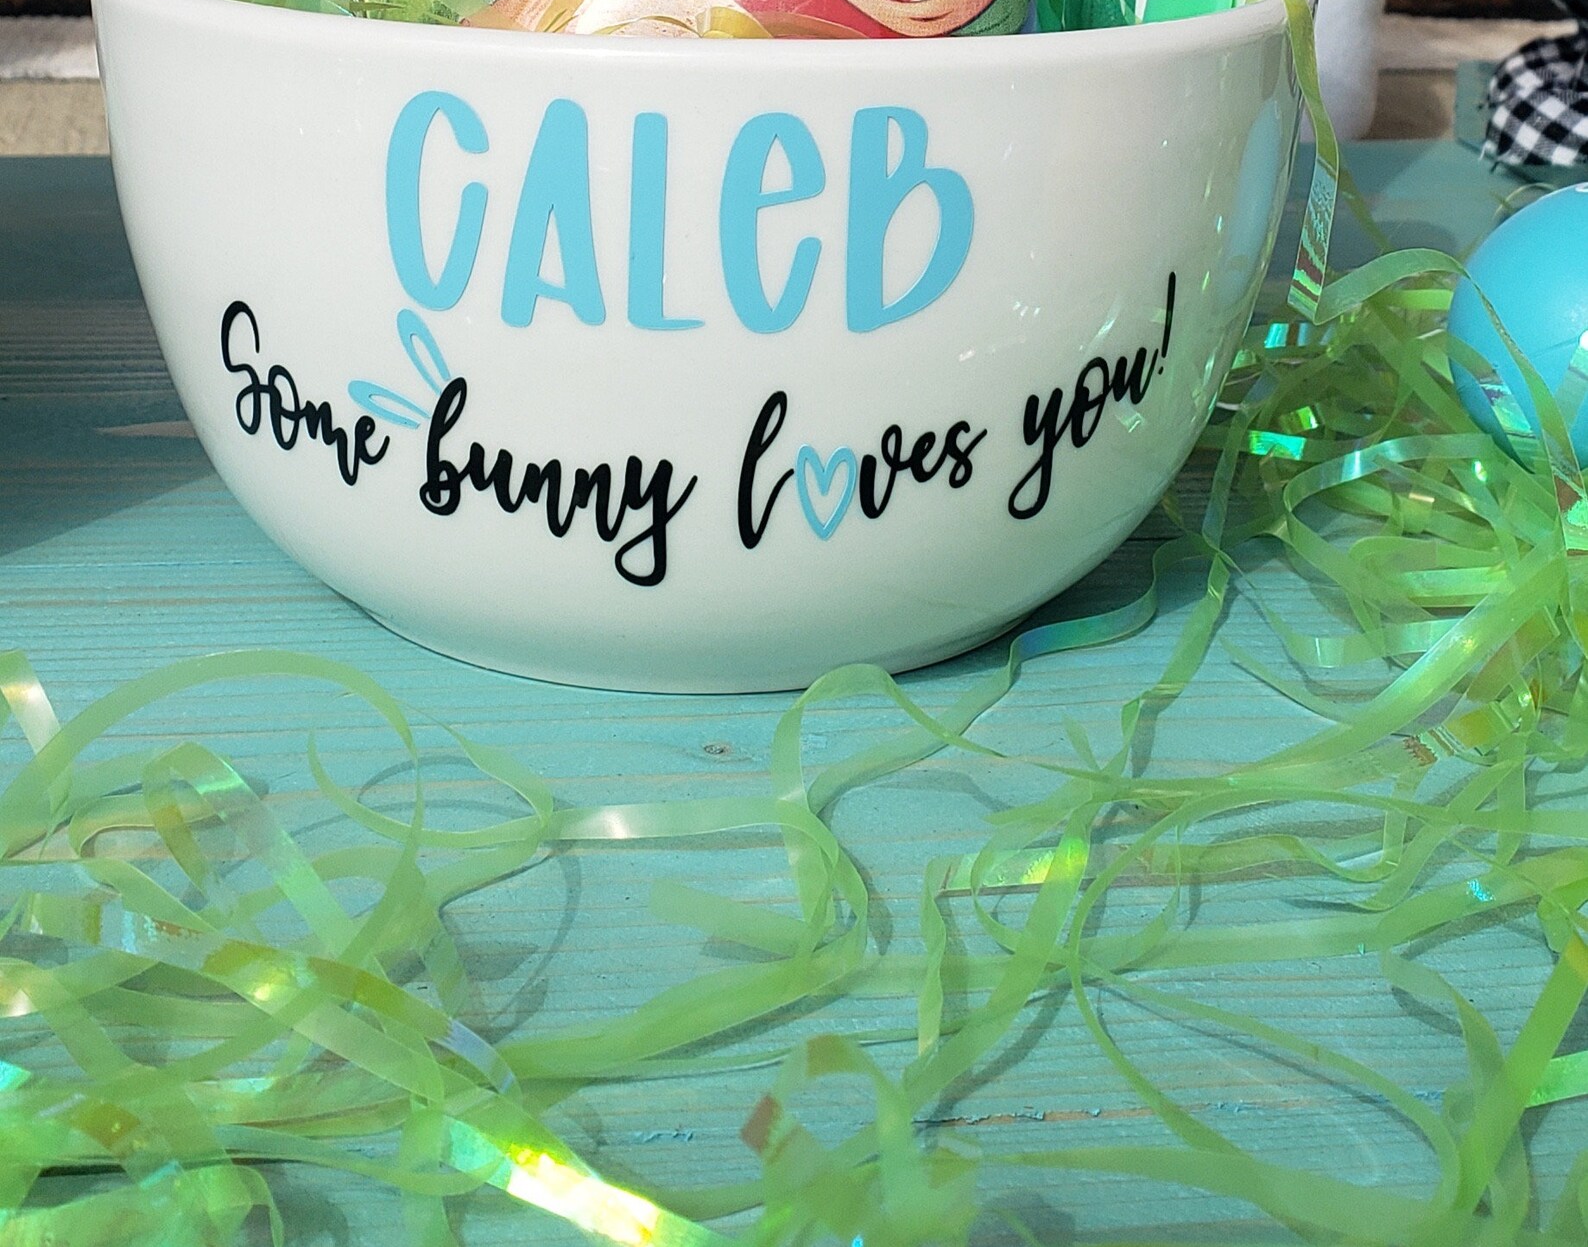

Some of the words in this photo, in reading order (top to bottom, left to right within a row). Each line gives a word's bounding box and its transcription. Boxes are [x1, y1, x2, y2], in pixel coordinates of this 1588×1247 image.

[220, 300, 390, 486] Some
[418, 377, 698, 587] bunny
[1007, 271, 1177, 520] you!
